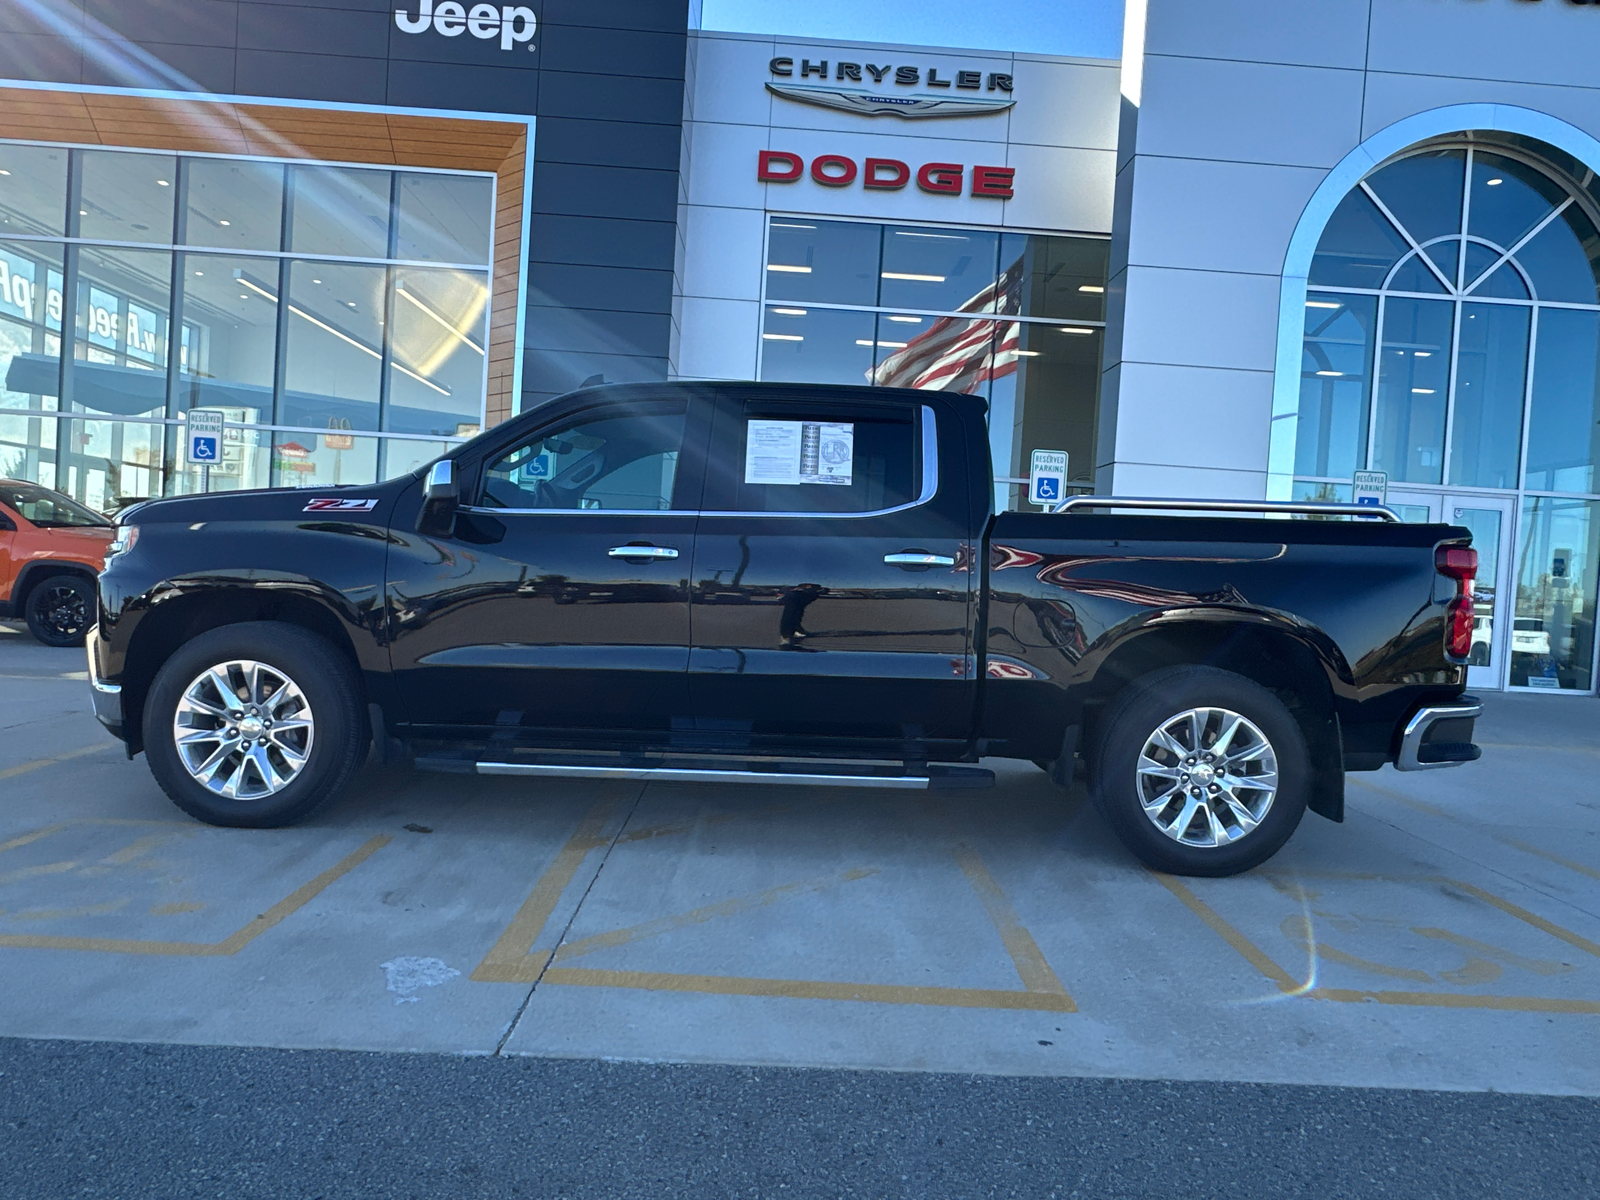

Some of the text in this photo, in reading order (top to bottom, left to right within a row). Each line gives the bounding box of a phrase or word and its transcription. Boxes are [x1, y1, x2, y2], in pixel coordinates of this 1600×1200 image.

[395, 0, 537, 51] Jeep
[769, 57, 1014, 92] CHRYSLER
[757, 150, 1016, 200] DODGE
[190, 415, 221, 423] RESERVED
[190, 424, 221, 432] PARKING
[1035, 455, 1064, 464] RESERVED
[1034, 464, 1064, 473] PARKING
[1356, 475, 1384, 483] RESERVED
[1355, 484, 1384, 492] PARKING
[302, 498, 379, 512] Z71
